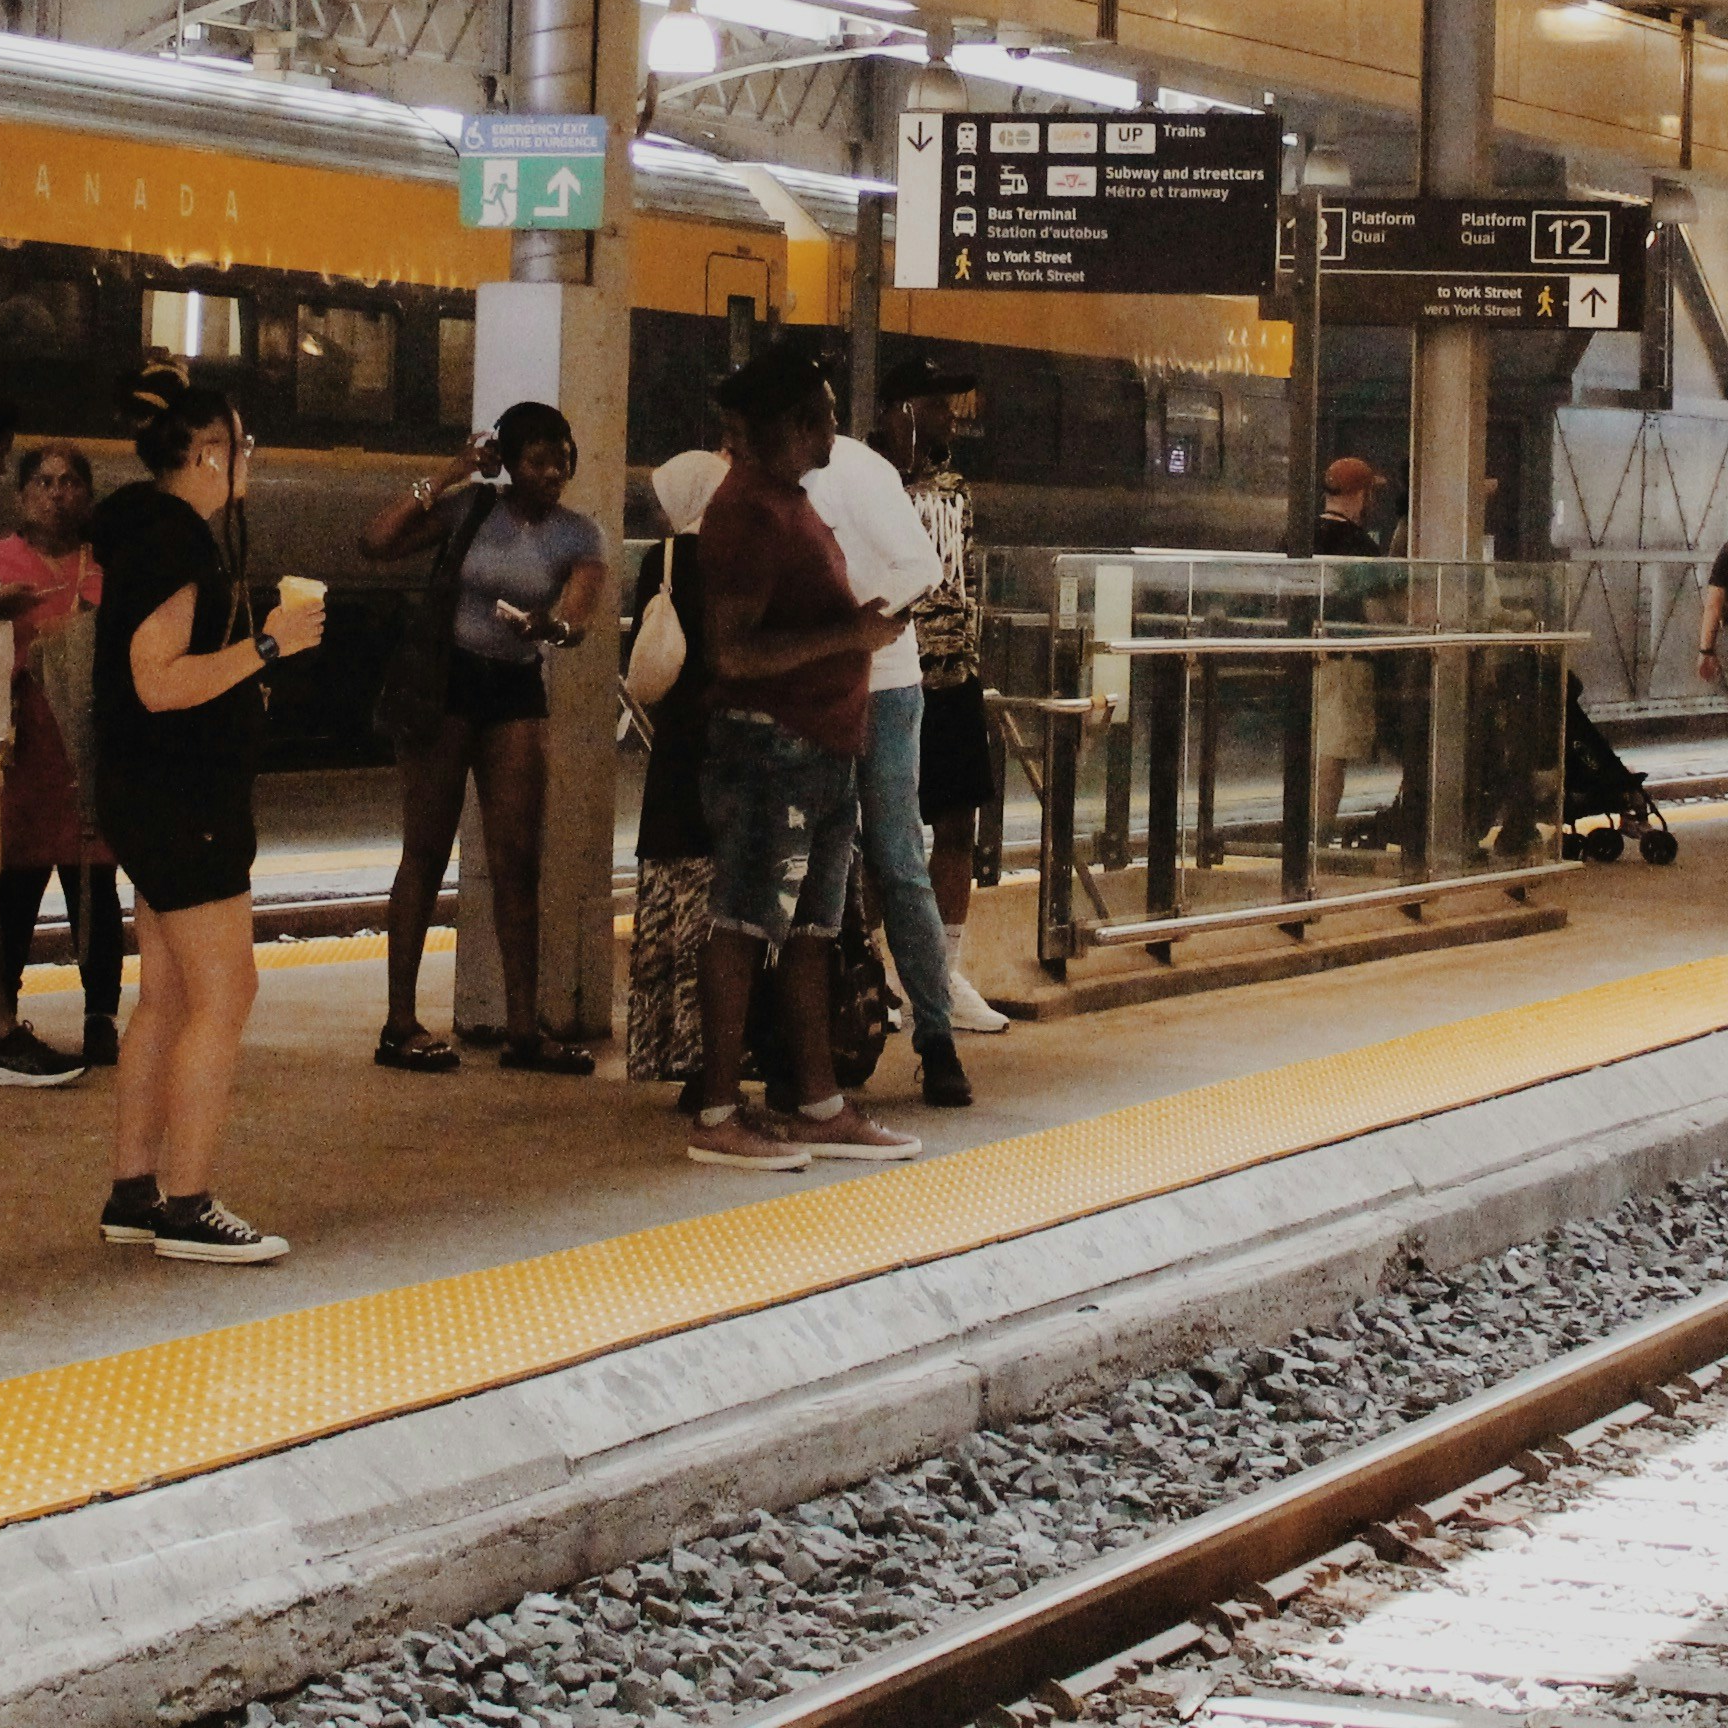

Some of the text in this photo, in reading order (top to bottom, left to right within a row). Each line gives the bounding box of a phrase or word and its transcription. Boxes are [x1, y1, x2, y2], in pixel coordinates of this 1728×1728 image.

[491, 123, 589, 135] EMERGENCY EXIT
[1118, 127, 1144, 142] UP
[1163, 124, 1206, 138] Trains
[491, 136, 599, 148] SORTIE D'URGENCE
[1105, 166, 1265, 181] Subway and streetcars
[1105, 184, 1229, 202] Métro et tramway
[988, 207, 1077, 221] Bus Terminal
[1352, 211, 1416, 226] Platform
[987, 225, 1108, 240] Station d'autobus
[1351, 230, 1385, 245] Quai
[1461, 213, 1592, 255] Platform 12
[1461, 231, 1495, 246] Quai
[986, 250, 1072, 264] to York Street
[986, 269, 1085, 283] vers York Street
[1437, 286, 1522, 299] to York Street
[1424, 304, 1521, 317] vers York Street
